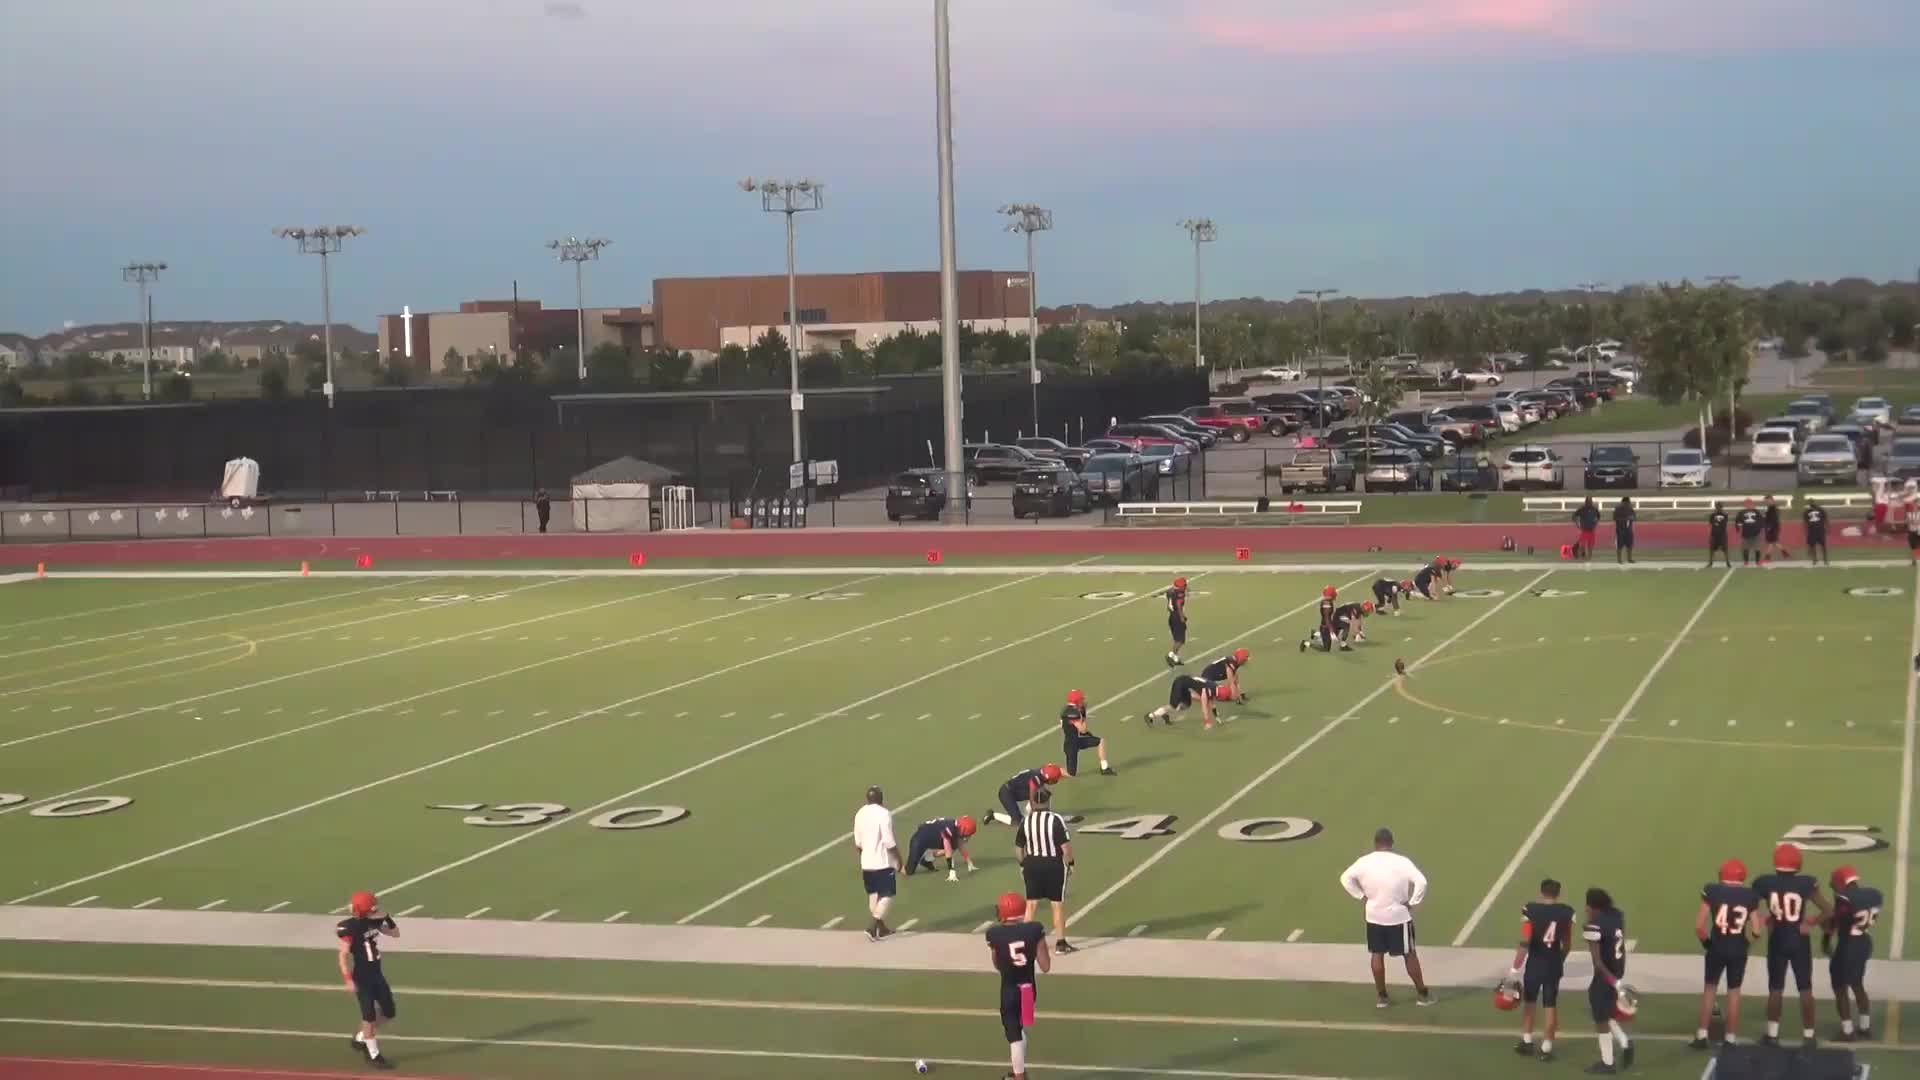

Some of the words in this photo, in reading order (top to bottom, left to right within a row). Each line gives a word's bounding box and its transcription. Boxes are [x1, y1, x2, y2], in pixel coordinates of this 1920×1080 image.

[1077, 814, 1314, 841] 40
[1779, 825, 1877, 851] 5
[1715, 903, 1748, 934] 43
[1770, 891, 1802, 922] 40
[1543, 920, 1557, 948] 4
[1008, 940, 1027, 967] 5
